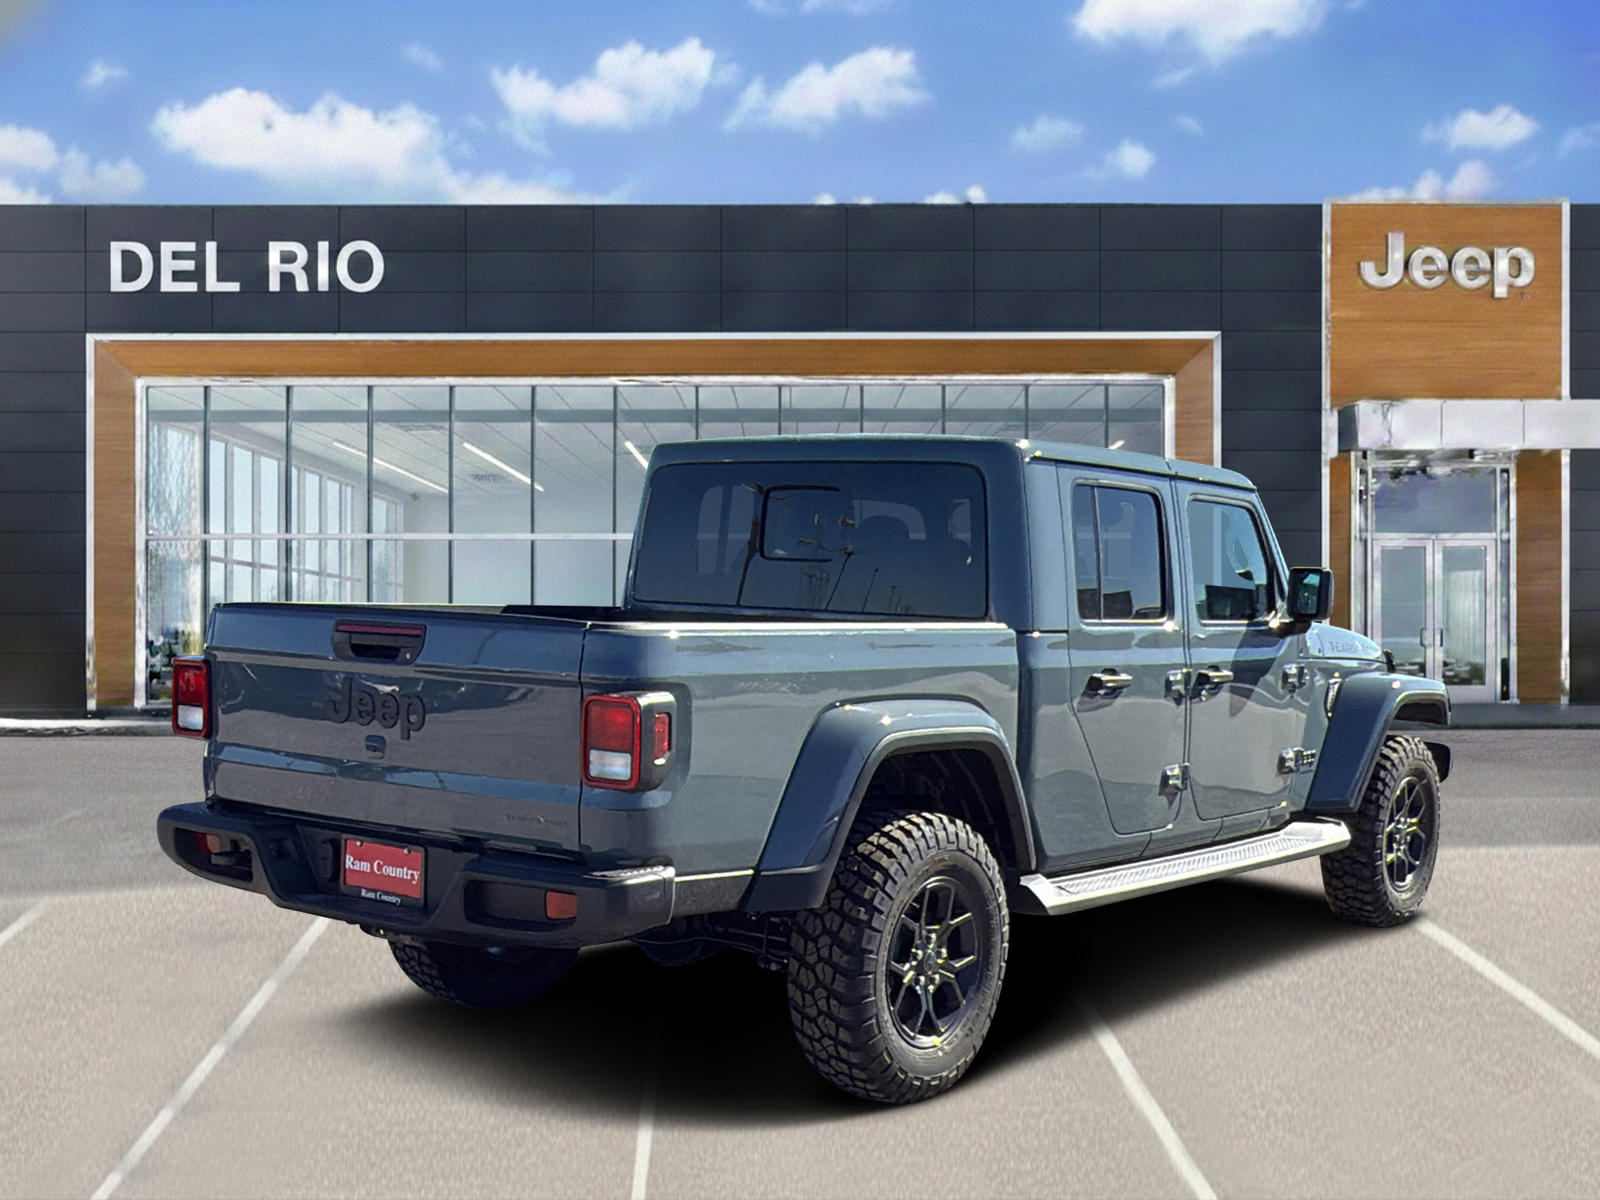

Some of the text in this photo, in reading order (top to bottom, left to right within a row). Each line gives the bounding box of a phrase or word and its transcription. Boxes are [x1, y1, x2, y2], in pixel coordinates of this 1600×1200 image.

[110, 240, 384, 292] DEL RIO
[1360, 231, 1535, 298] Jeep
[328, 676, 426, 740] Jeep
[345, 854, 420, 884] Ram Country
[361, 888, 401, 905] Ram Country
